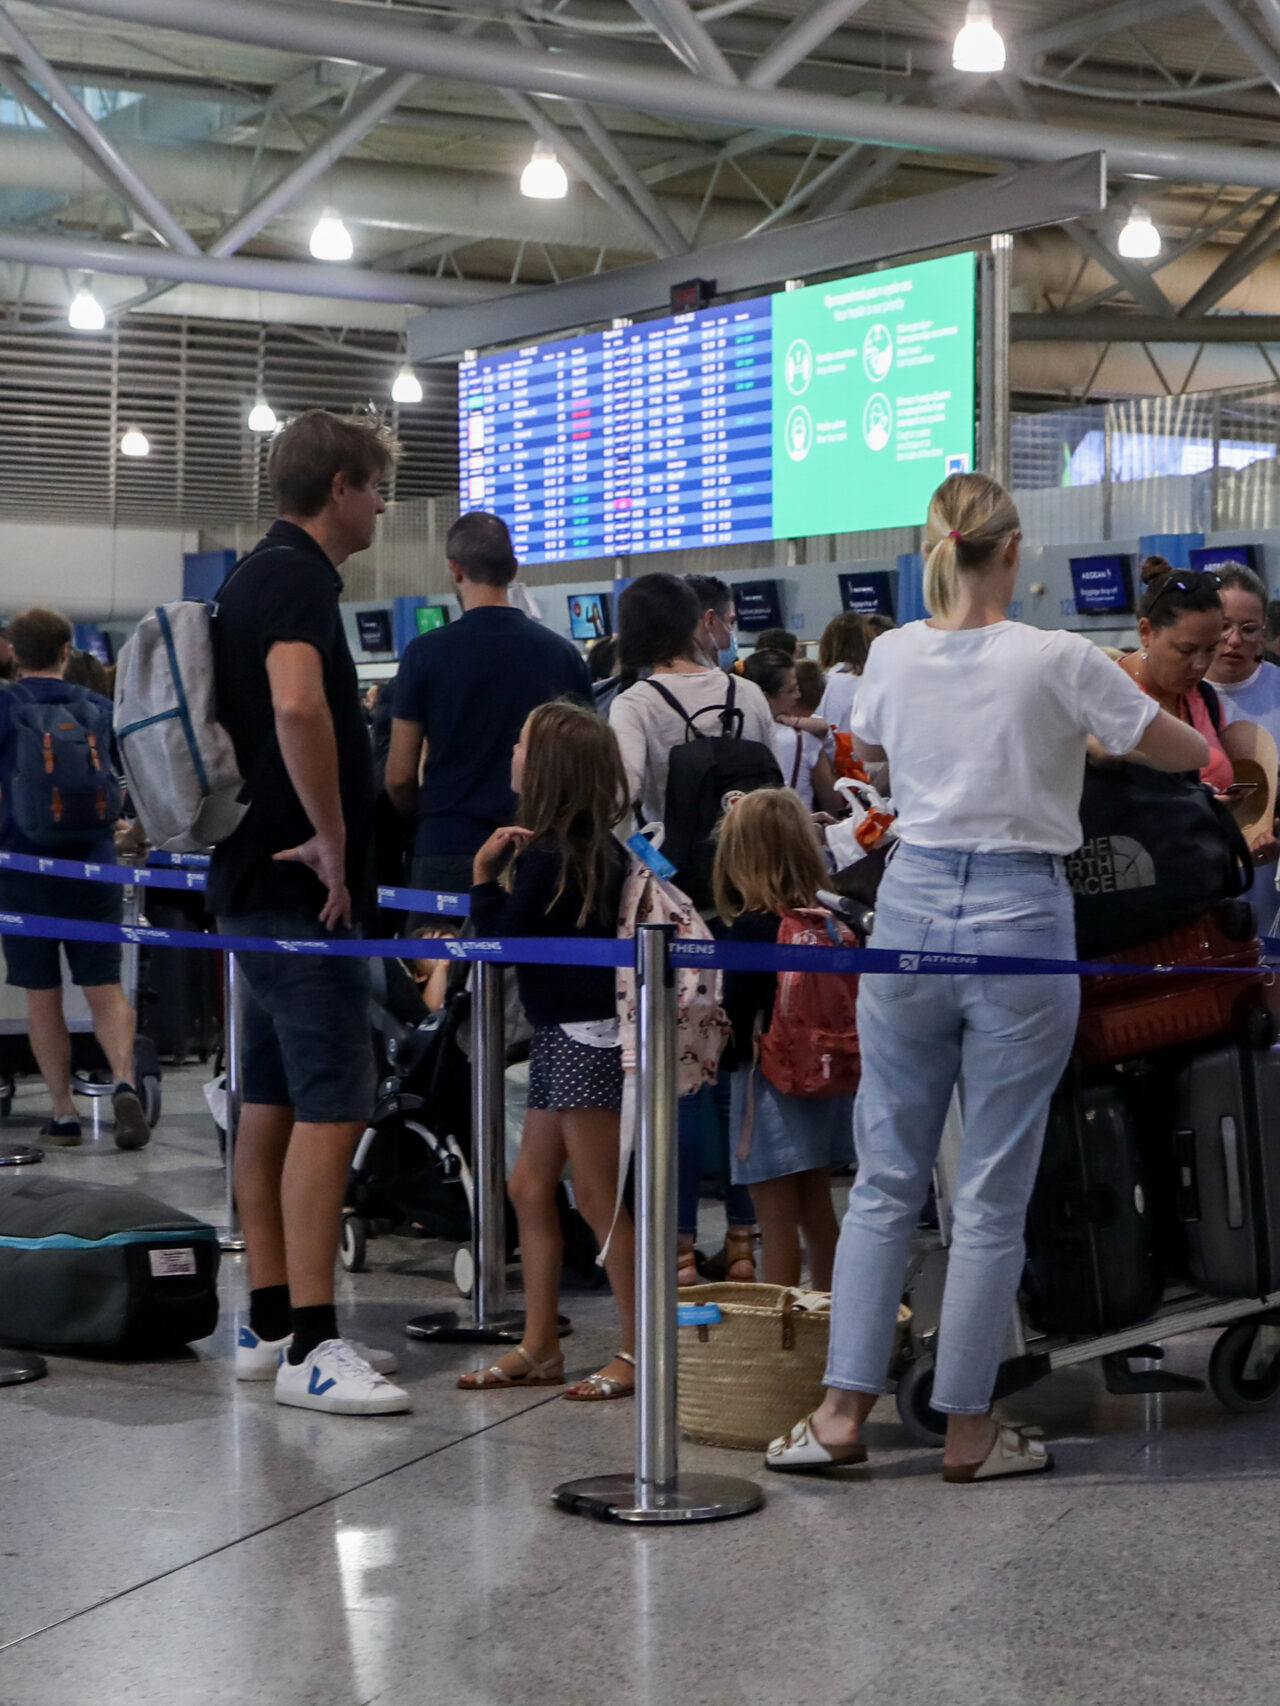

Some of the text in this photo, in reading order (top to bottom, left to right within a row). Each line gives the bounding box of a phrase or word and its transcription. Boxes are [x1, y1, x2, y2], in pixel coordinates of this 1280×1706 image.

[1071, 837, 1109, 859] HE
[1067, 855, 1113, 877] RTH
[1072, 875, 1115, 895] ACE
[461, 941, 502, 950] ATHENS
[667, 942, 715, 954] THENS
[921, 955, 978, 965] ATHENS
